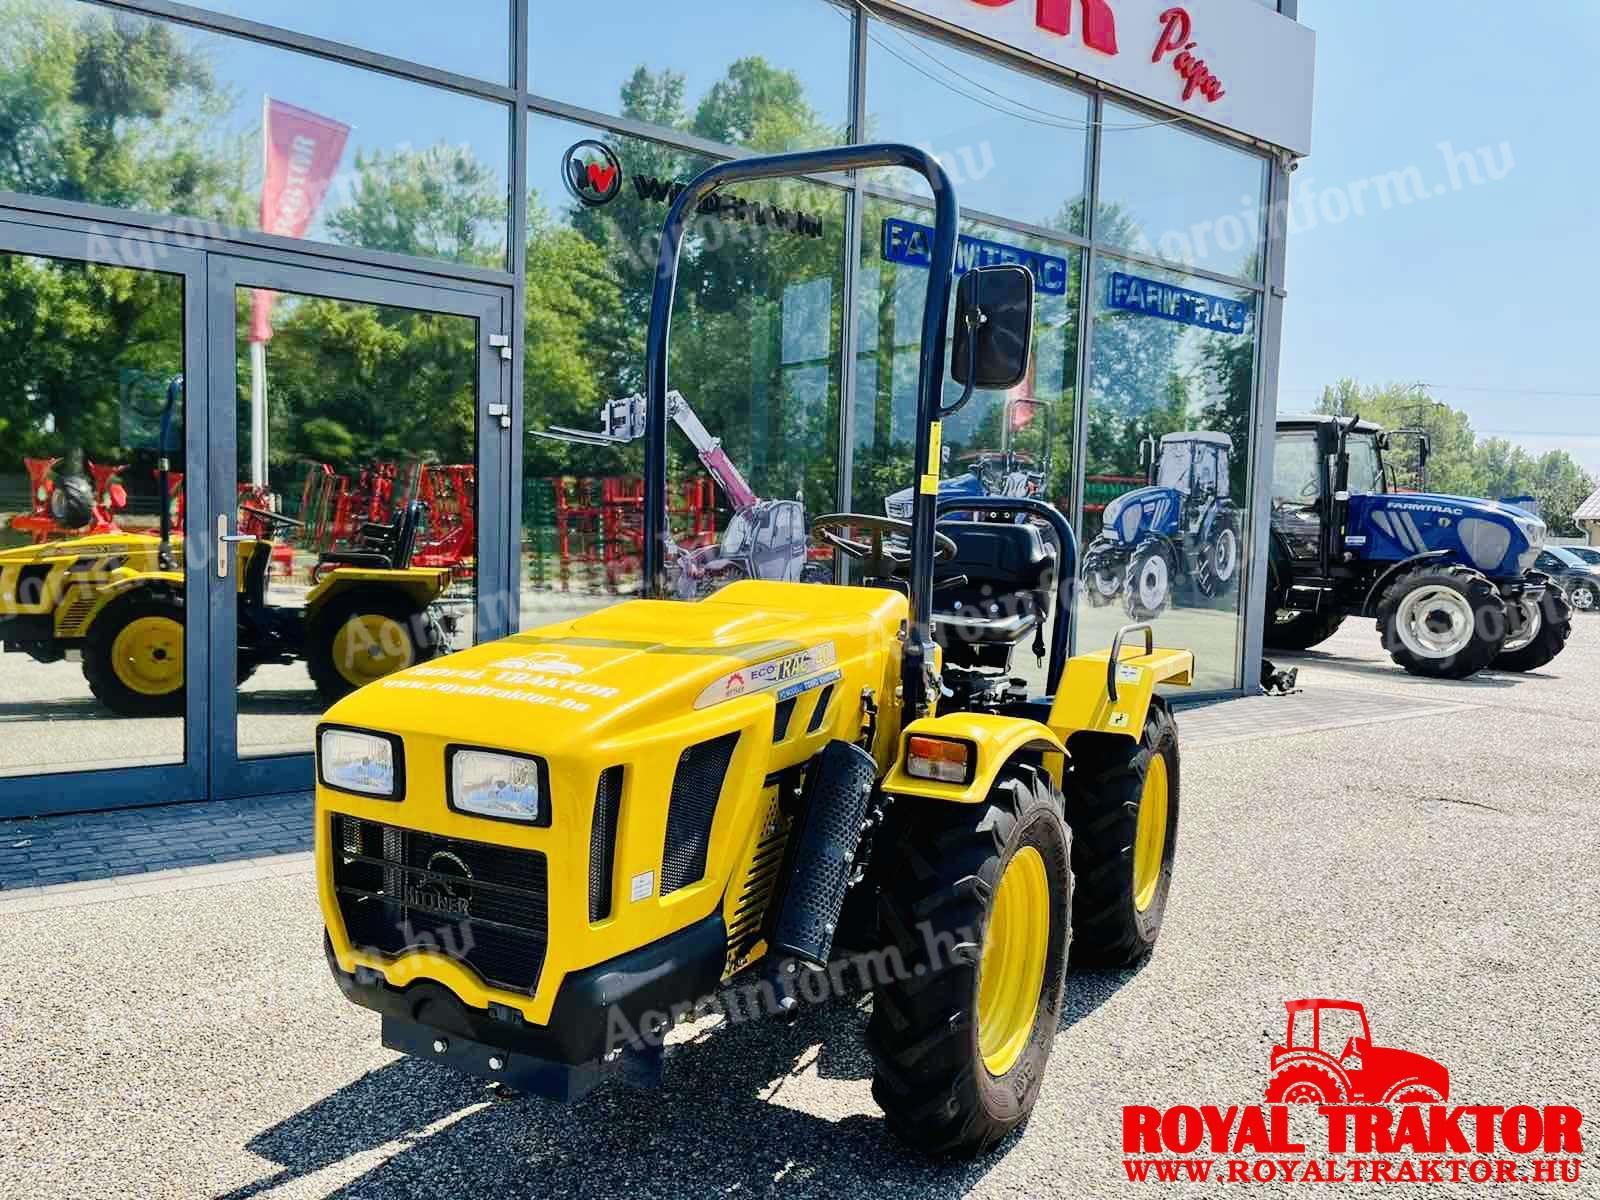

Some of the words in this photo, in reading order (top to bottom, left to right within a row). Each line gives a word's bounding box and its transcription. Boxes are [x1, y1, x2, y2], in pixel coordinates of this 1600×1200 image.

[1152, 8, 1226, 103] Pápa
[1386, 501, 1463, 516] FARMTRAC
[494, 670, 620, 698] TRAKTOR
